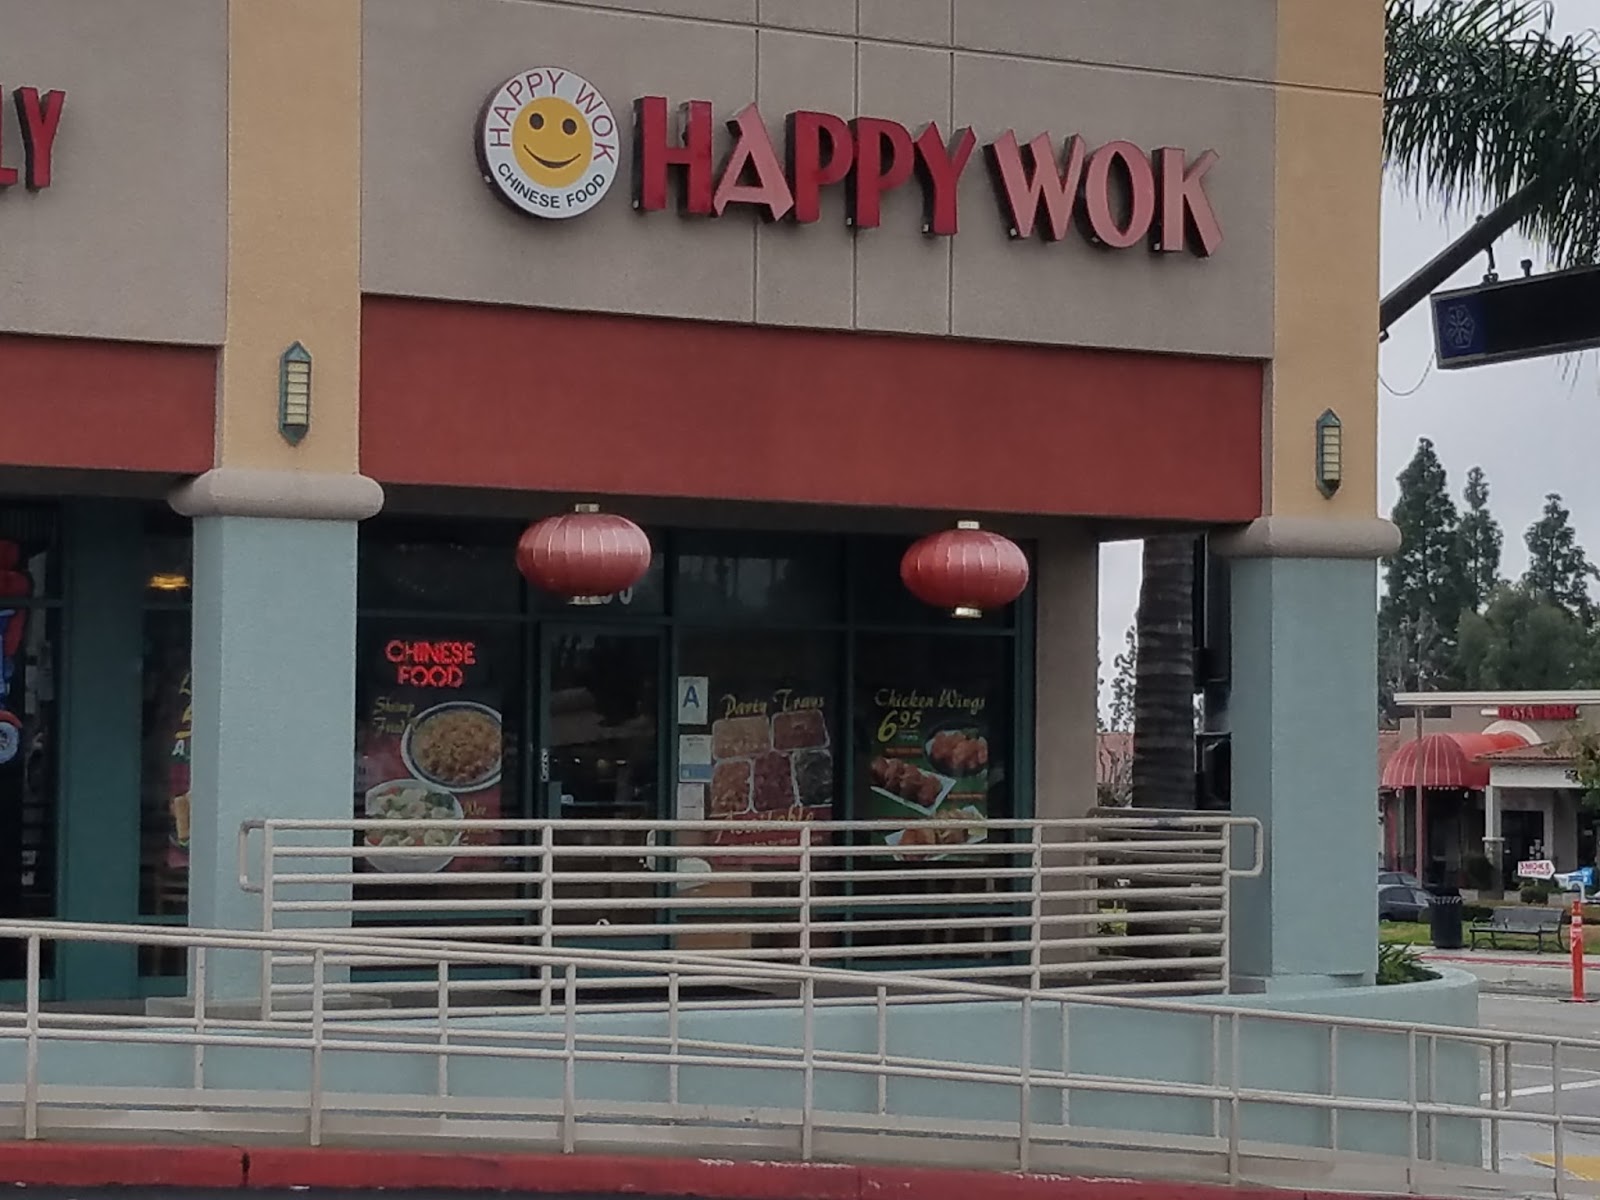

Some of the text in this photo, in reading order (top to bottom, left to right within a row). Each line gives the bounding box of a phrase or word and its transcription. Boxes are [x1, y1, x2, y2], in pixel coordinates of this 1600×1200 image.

[489, 69, 617, 166] HAPPY WOK
[497, 161, 607, 209] CHINESE FOOD
[633, 96, 1224, 257] HAPPY WOK
[385, 639, 476, 665] CHINESE
[397, 665, 464, 688] FOOD
[682, 685, 700, 709] A
[874, 688, 986, 715] Chicken Wings
